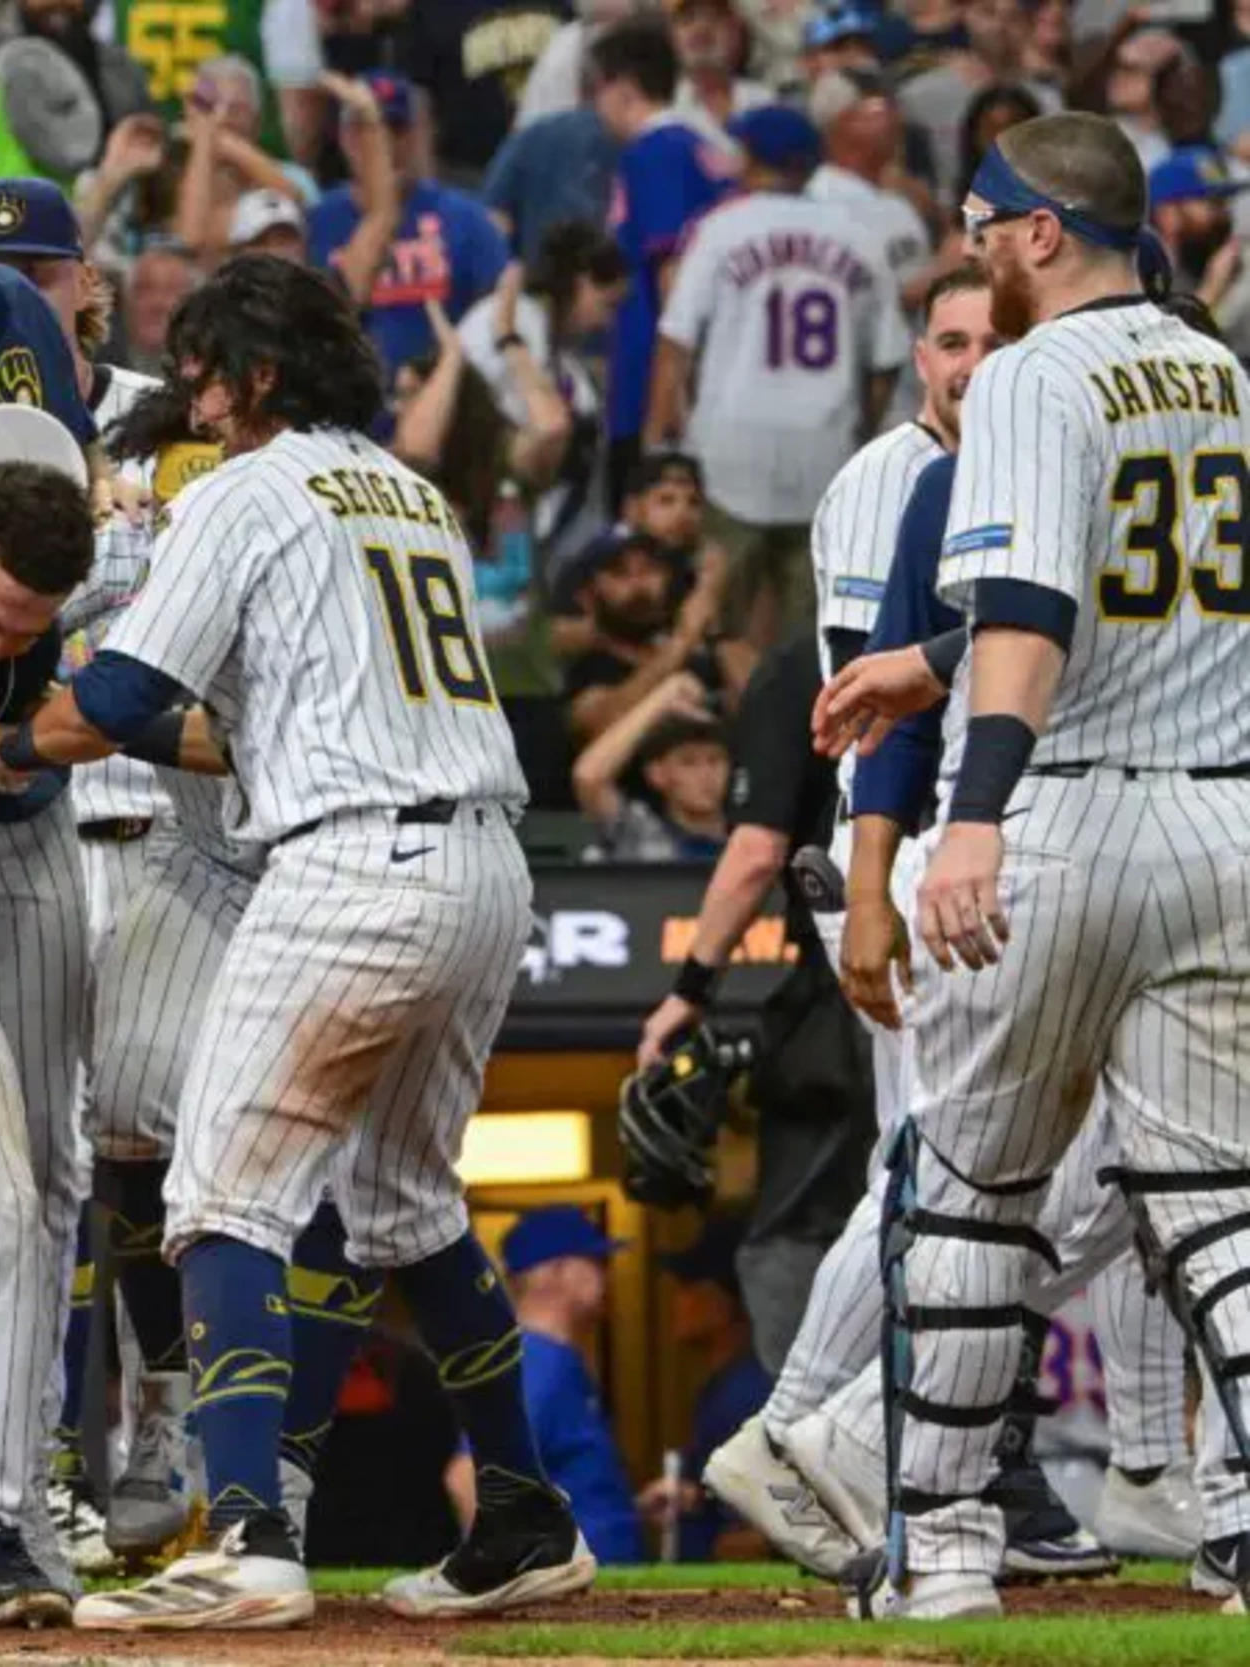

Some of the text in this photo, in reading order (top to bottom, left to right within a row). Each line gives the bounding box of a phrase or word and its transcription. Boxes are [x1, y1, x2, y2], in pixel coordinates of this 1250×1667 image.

[127, 1, 226, 101] 55
[765, 284, 838, 372] 18
[1088, 355, 1241, 424] JANSEN
[1093, 445, 1250, 623] 33
[361, 543, 500, 712] 18
